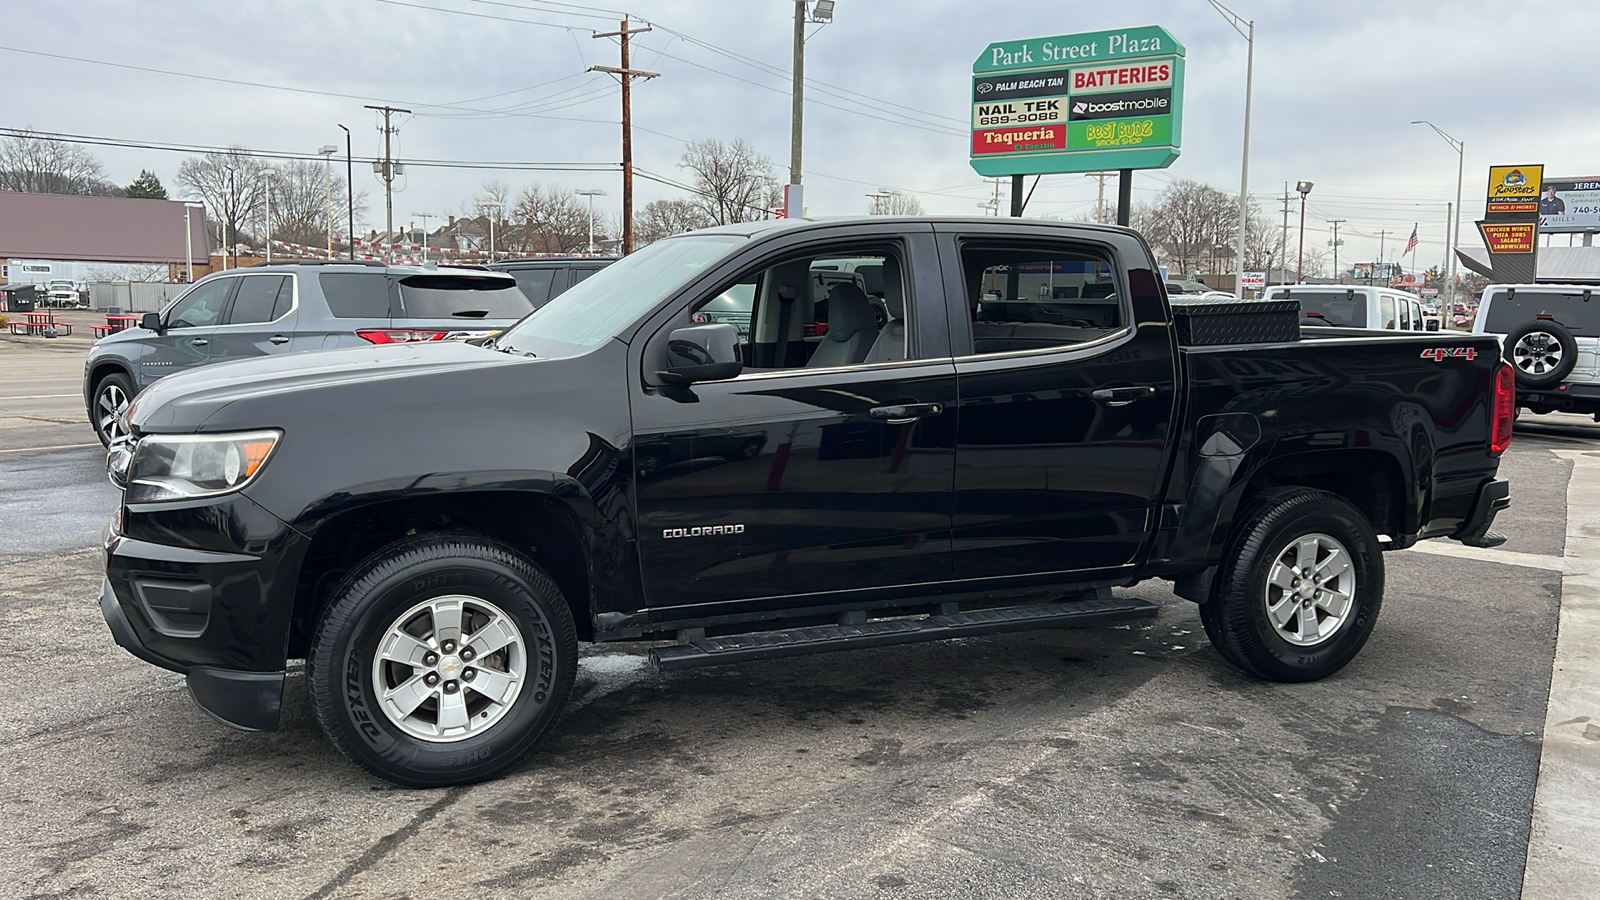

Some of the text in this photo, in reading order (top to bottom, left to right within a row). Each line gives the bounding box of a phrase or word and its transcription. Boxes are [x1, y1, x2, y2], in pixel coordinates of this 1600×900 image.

[992, 33, 1161, 66] Park Street Plaza
[1074, 64, 1170, 89] BATTERIES
[995, 77, 1064, 92] PALM BEACH TAN
[978, 100, 1060, 116] NAIL TEK
[980, 112, 1059, 125] 689-9088
[1095, 137, 1142, 147] SMOKE SHOP
[1494, 184, 1535, 196] Roosters
[1573, 206, 1600, 214] 740-5
[662, 524, 745, 539] COLORADO
[346, 636, 382, 745] DEXTERO
